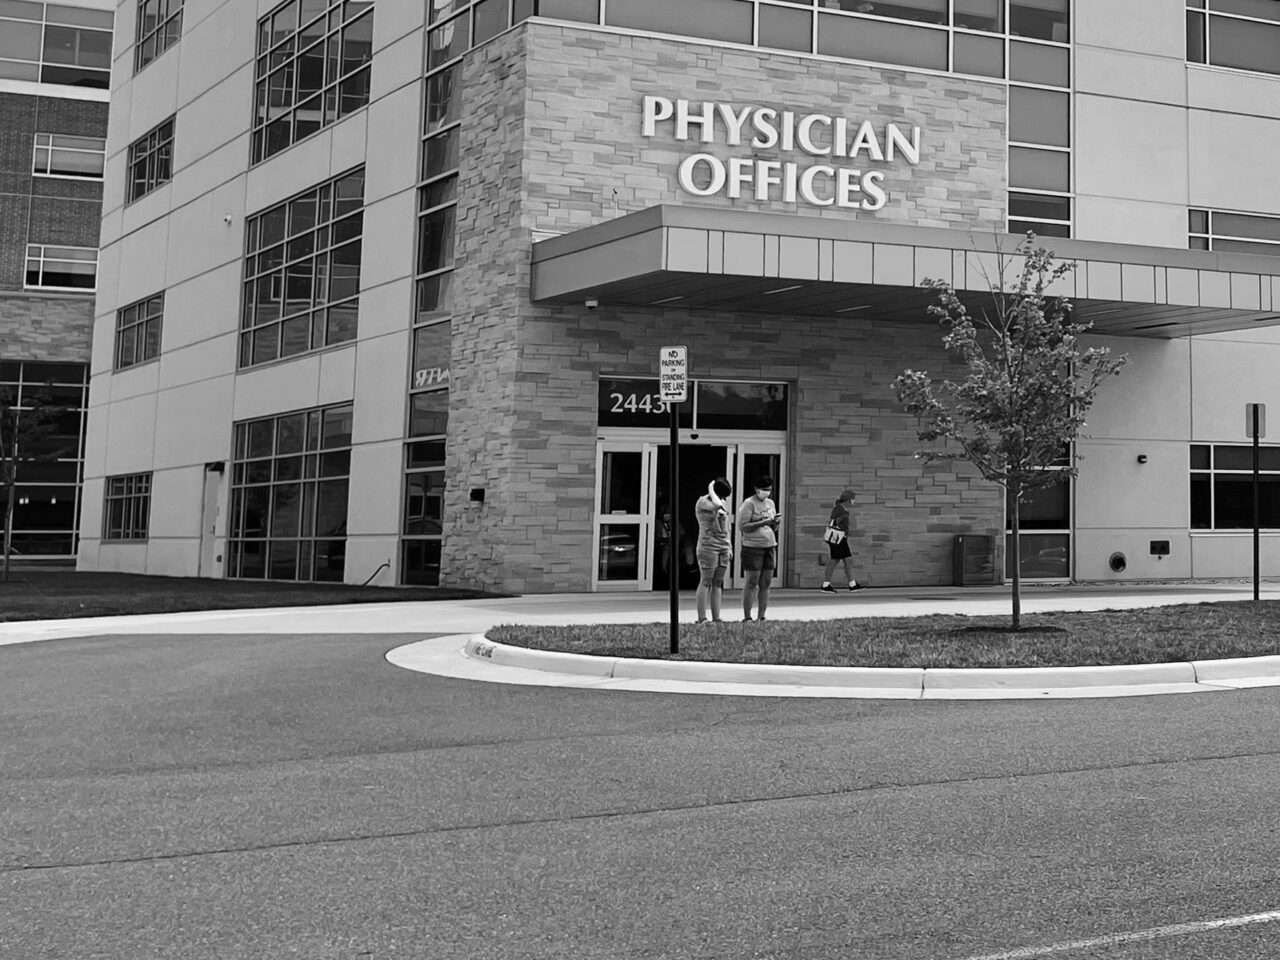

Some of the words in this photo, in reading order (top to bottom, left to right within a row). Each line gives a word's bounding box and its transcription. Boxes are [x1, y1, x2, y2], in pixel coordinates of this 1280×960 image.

[641, 95, 921, 164] PHYSICIAN
[678, 153, 887, 211] OFFICES
[668, 350, 679, 358] NO
[661, 359, 685, 367] PARKING
[662, 373, 685, 381] STANDING
[661, 382, 671, 391] FIRE
[672, 382, 685, 391] LANE
